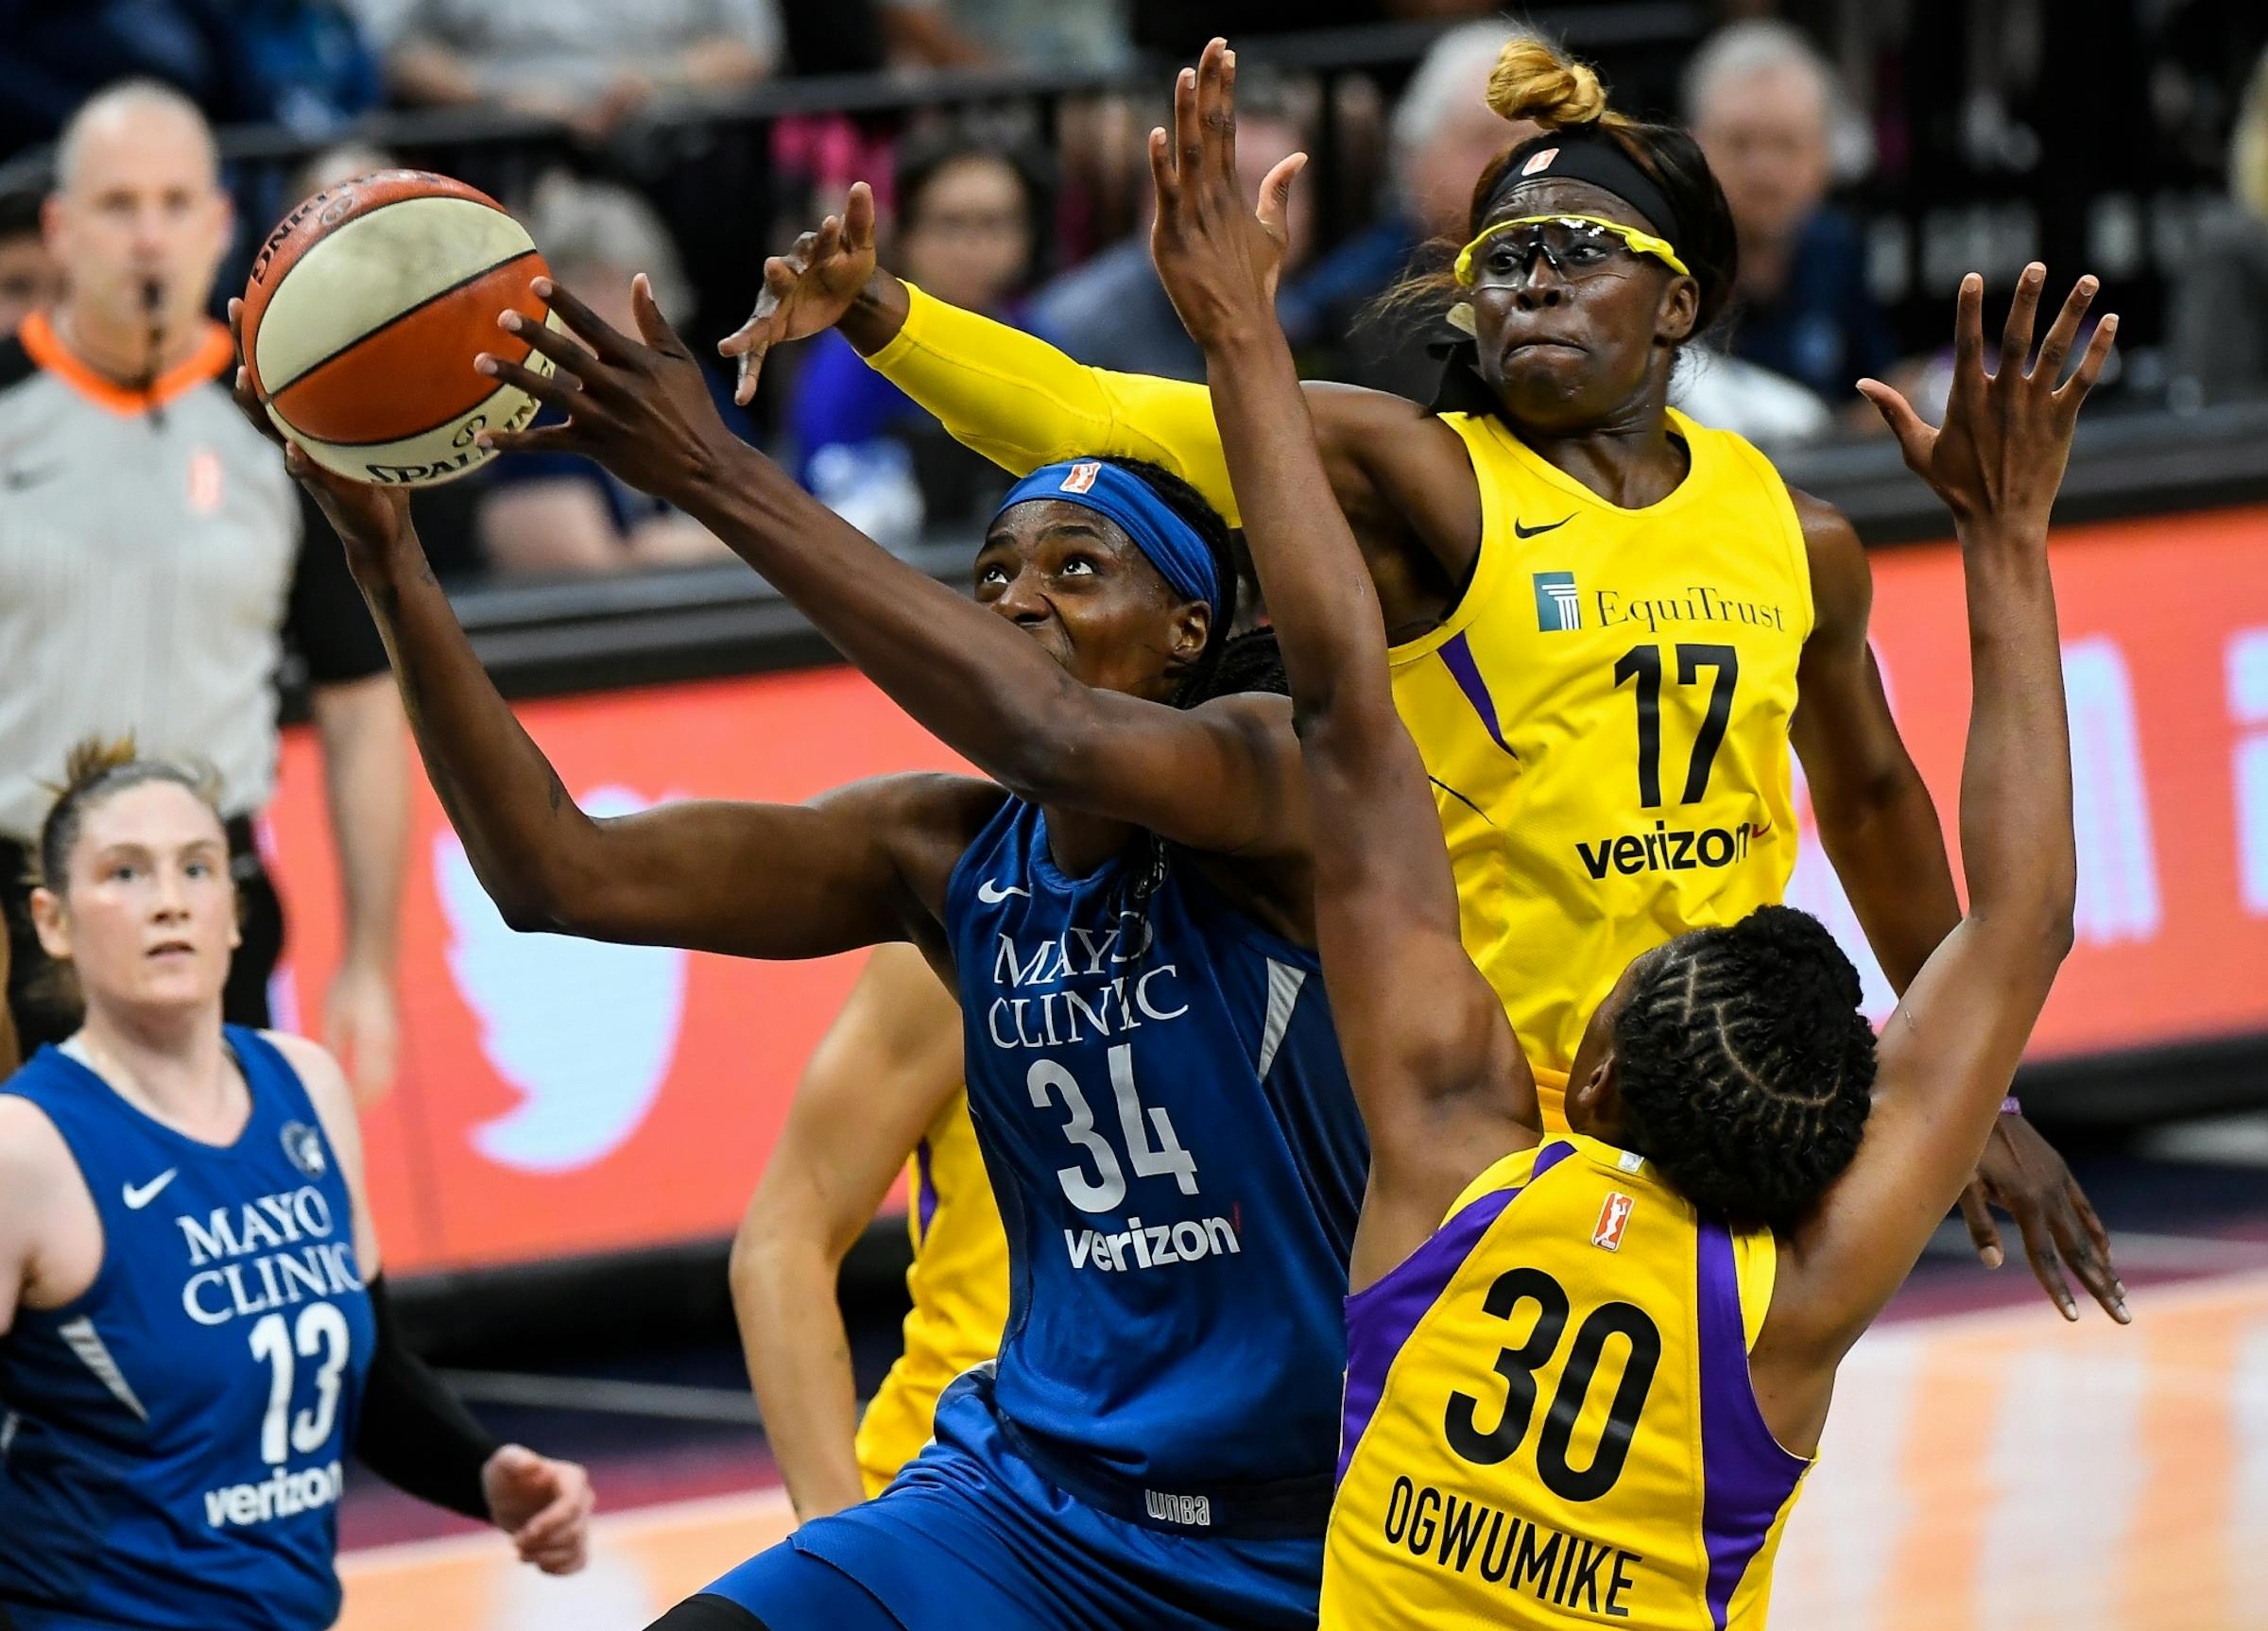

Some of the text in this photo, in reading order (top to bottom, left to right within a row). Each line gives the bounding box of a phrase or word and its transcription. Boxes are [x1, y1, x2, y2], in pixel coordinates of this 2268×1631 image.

[366, 355, 556, 485] SPALIN
[1594, 586, 1785, 633] EquiTrust
[1613, 643, 1740, 809] 17
[1575, 819, 1751, 881] verizon
[988, 964, 1190, 1050] CLINIC
[1025, 1041, 1200, 1214] 34
[175, 1184, 334, 1267] MAYO
[1063, 1217, 1241, 1272] verizon
[181, 1241, 366, 1326] CLINIC
[249, 1300, 351, 1466] 13
[1443, 1266, 1662, 1502] 30
[1384, 1474, 1643, 1619] OGWUMIKE
